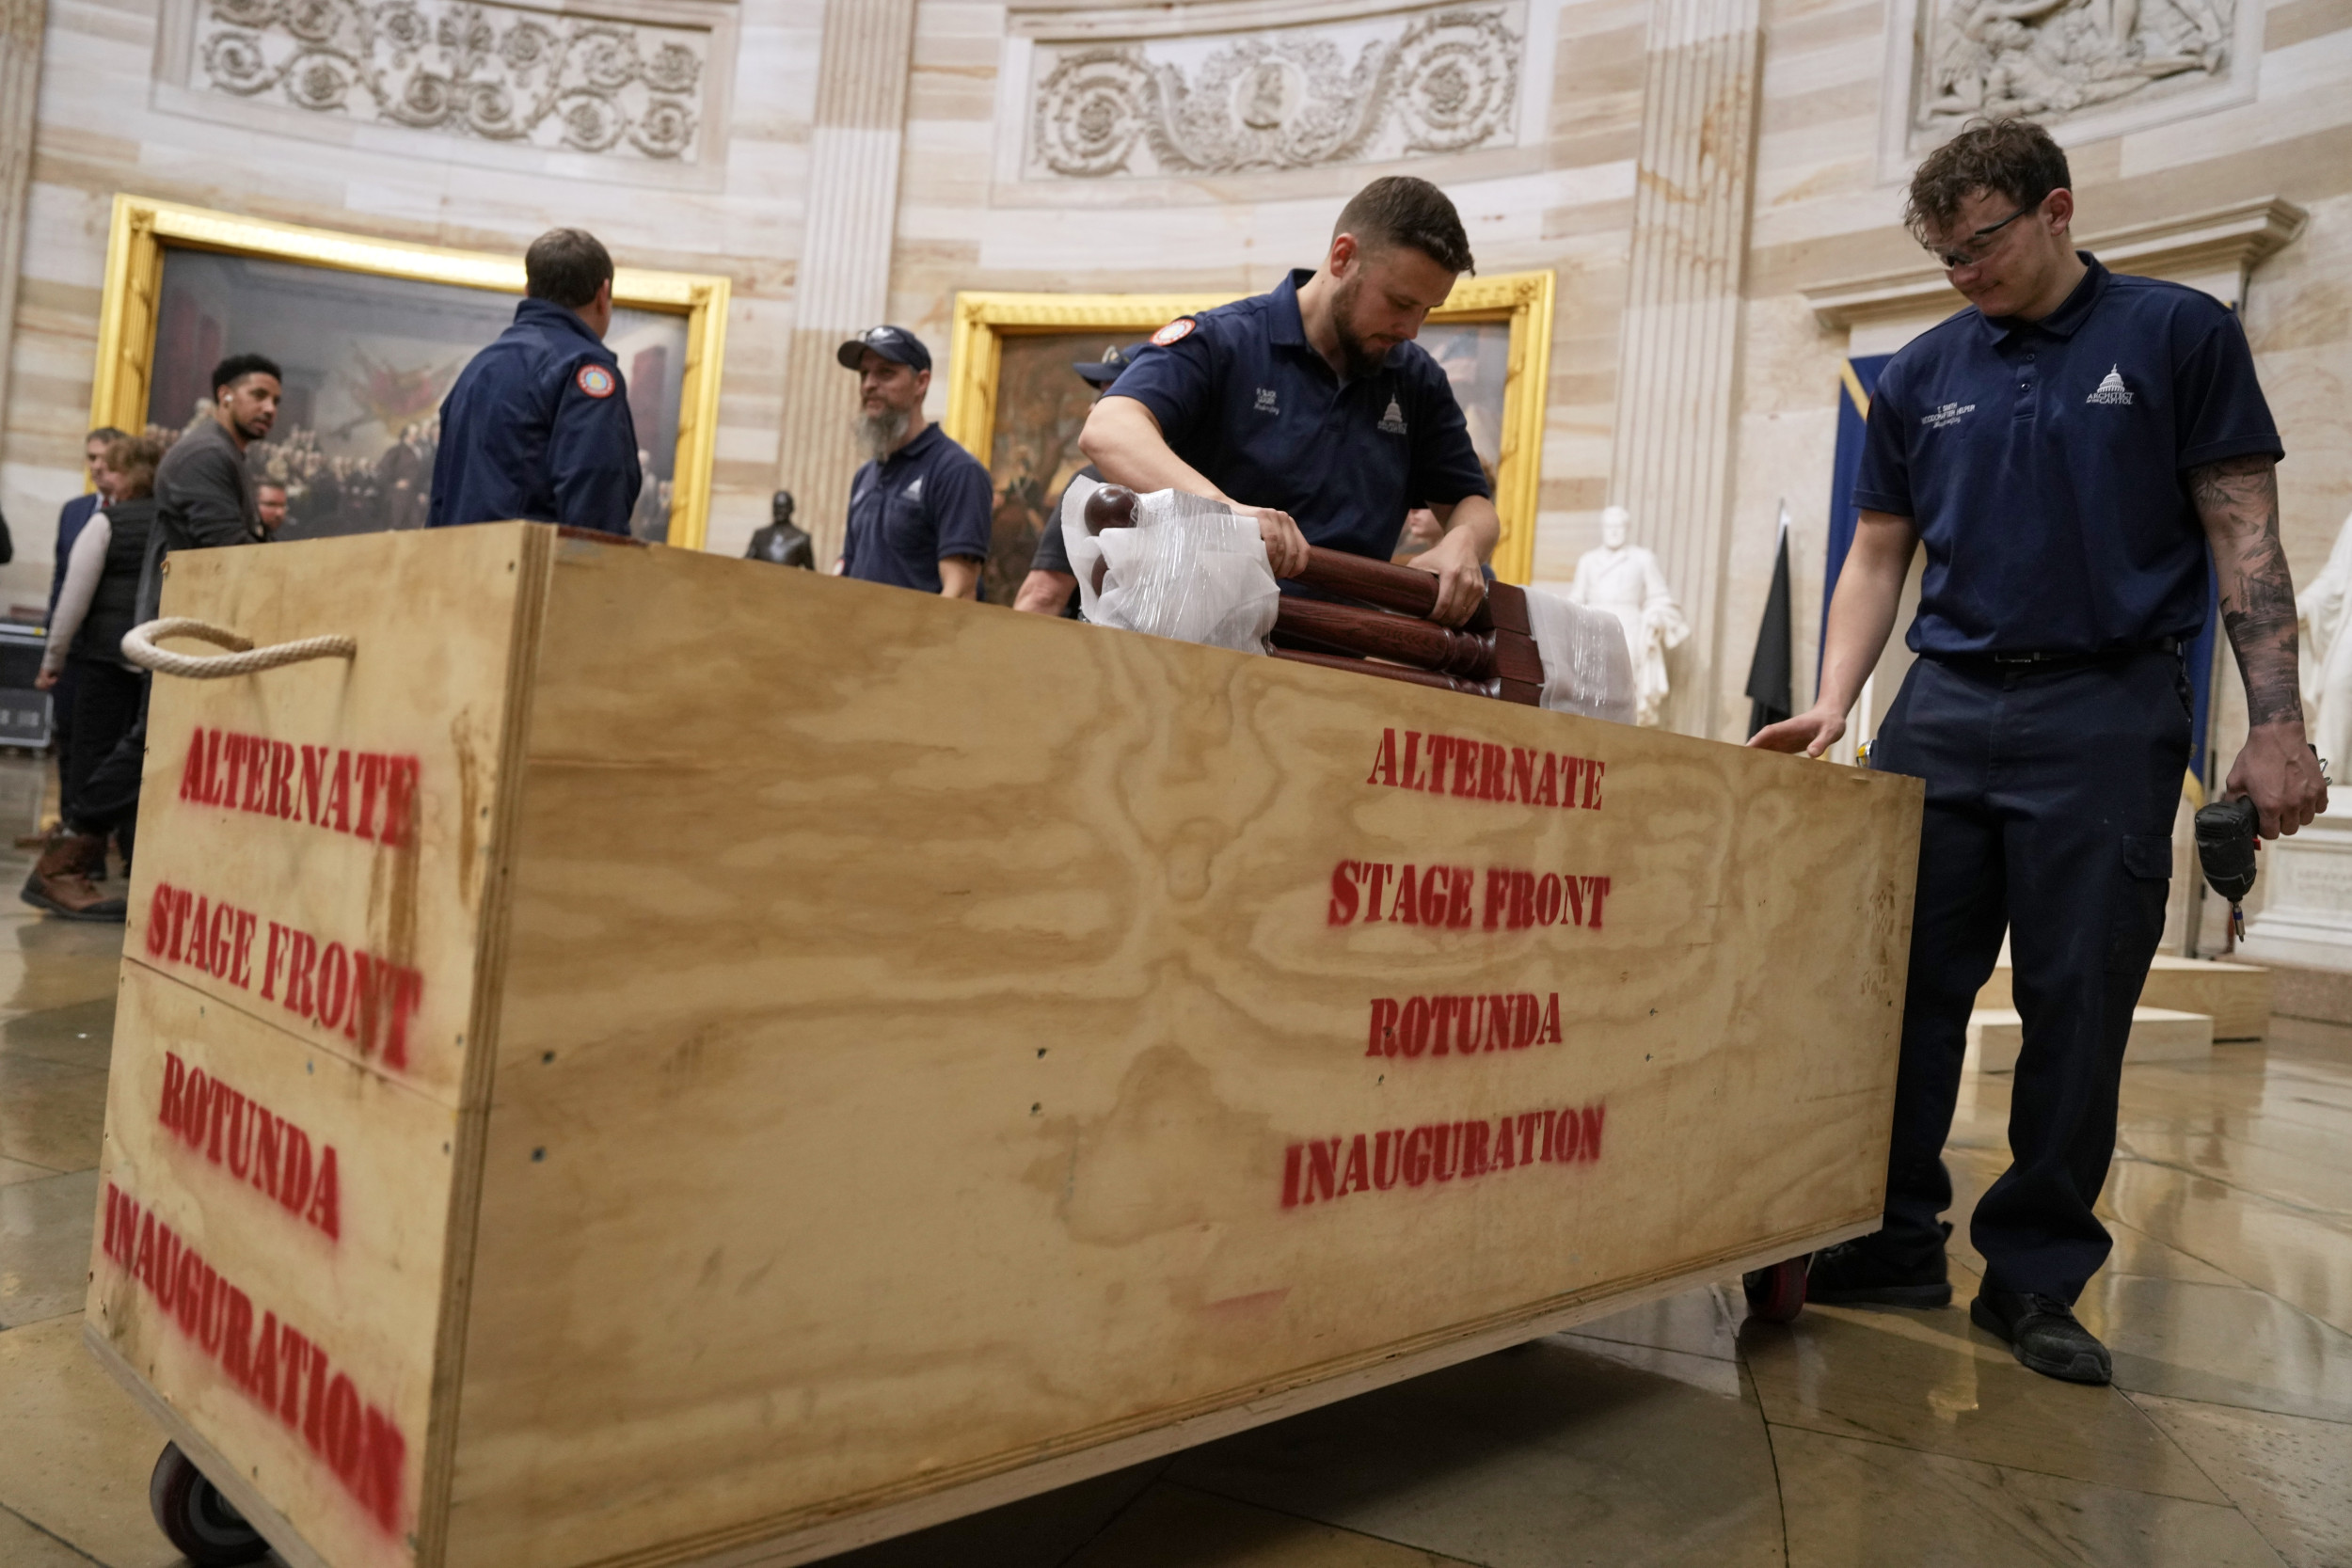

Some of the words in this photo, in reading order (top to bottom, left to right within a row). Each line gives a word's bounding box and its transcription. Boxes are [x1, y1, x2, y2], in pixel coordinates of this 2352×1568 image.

[2087, 392, 2135, 401] ARCHITECT
[180, 726, 420, 847] ALTERNATE
[1367, 728, 1605, 810] ALTERNATE
[1328, 859, 1473, 929] STAGE
[1483, 867, 1611, 930] FRONT
[147, 882, 257, 990] STAGE
[261, 921, 422, 1070] FRONT
[1366, 992, 1562, 1057] ROTUNDA
[159, 1051, 340, 1243] ROTUNDA
[1280, 1103, 1605, 1208] INAUGURATION
[103, 1183, 405, 1536] INAUGURATION
